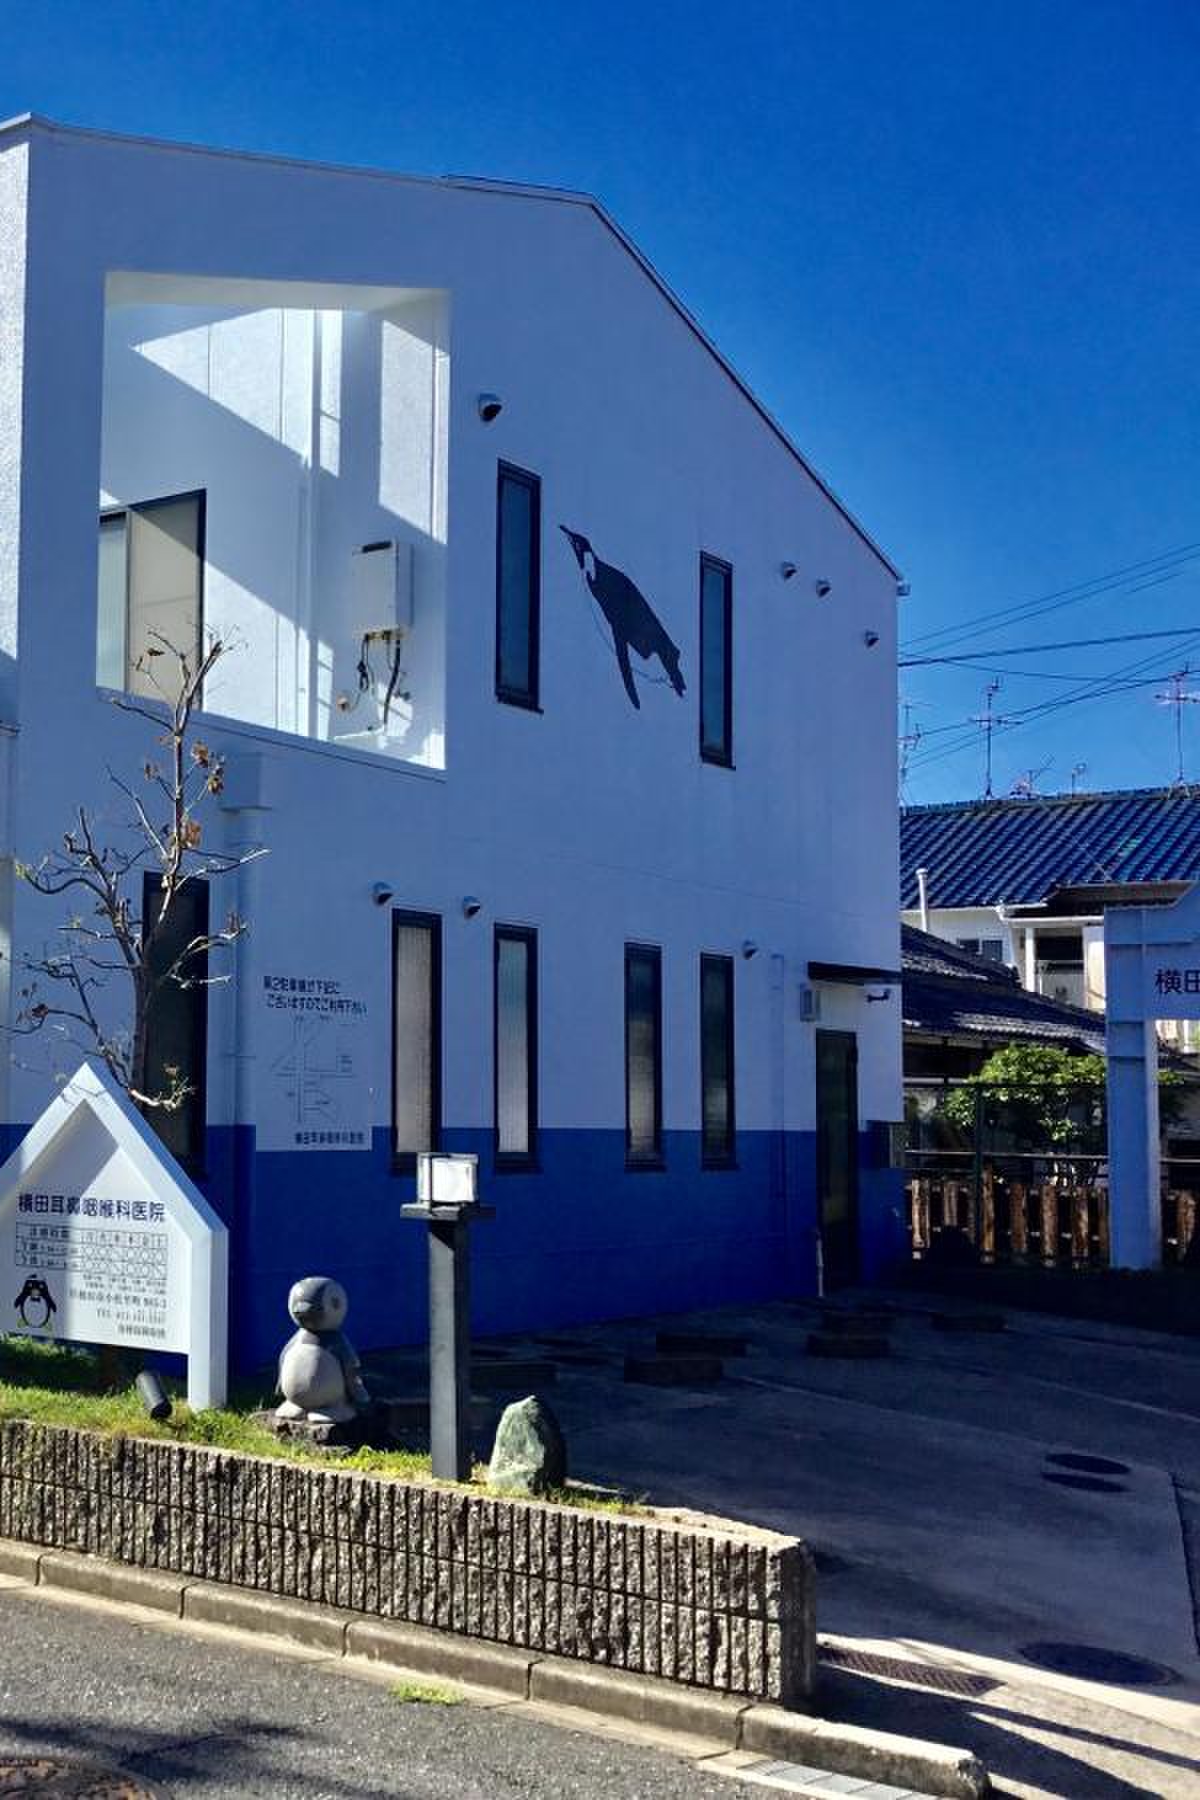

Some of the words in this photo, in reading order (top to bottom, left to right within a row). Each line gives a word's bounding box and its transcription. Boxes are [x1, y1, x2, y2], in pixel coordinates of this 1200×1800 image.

[1154, 968, 1200, 995] 横田
[18, 1193, 165, 1222] 横田耳鼻咽喉科医院
